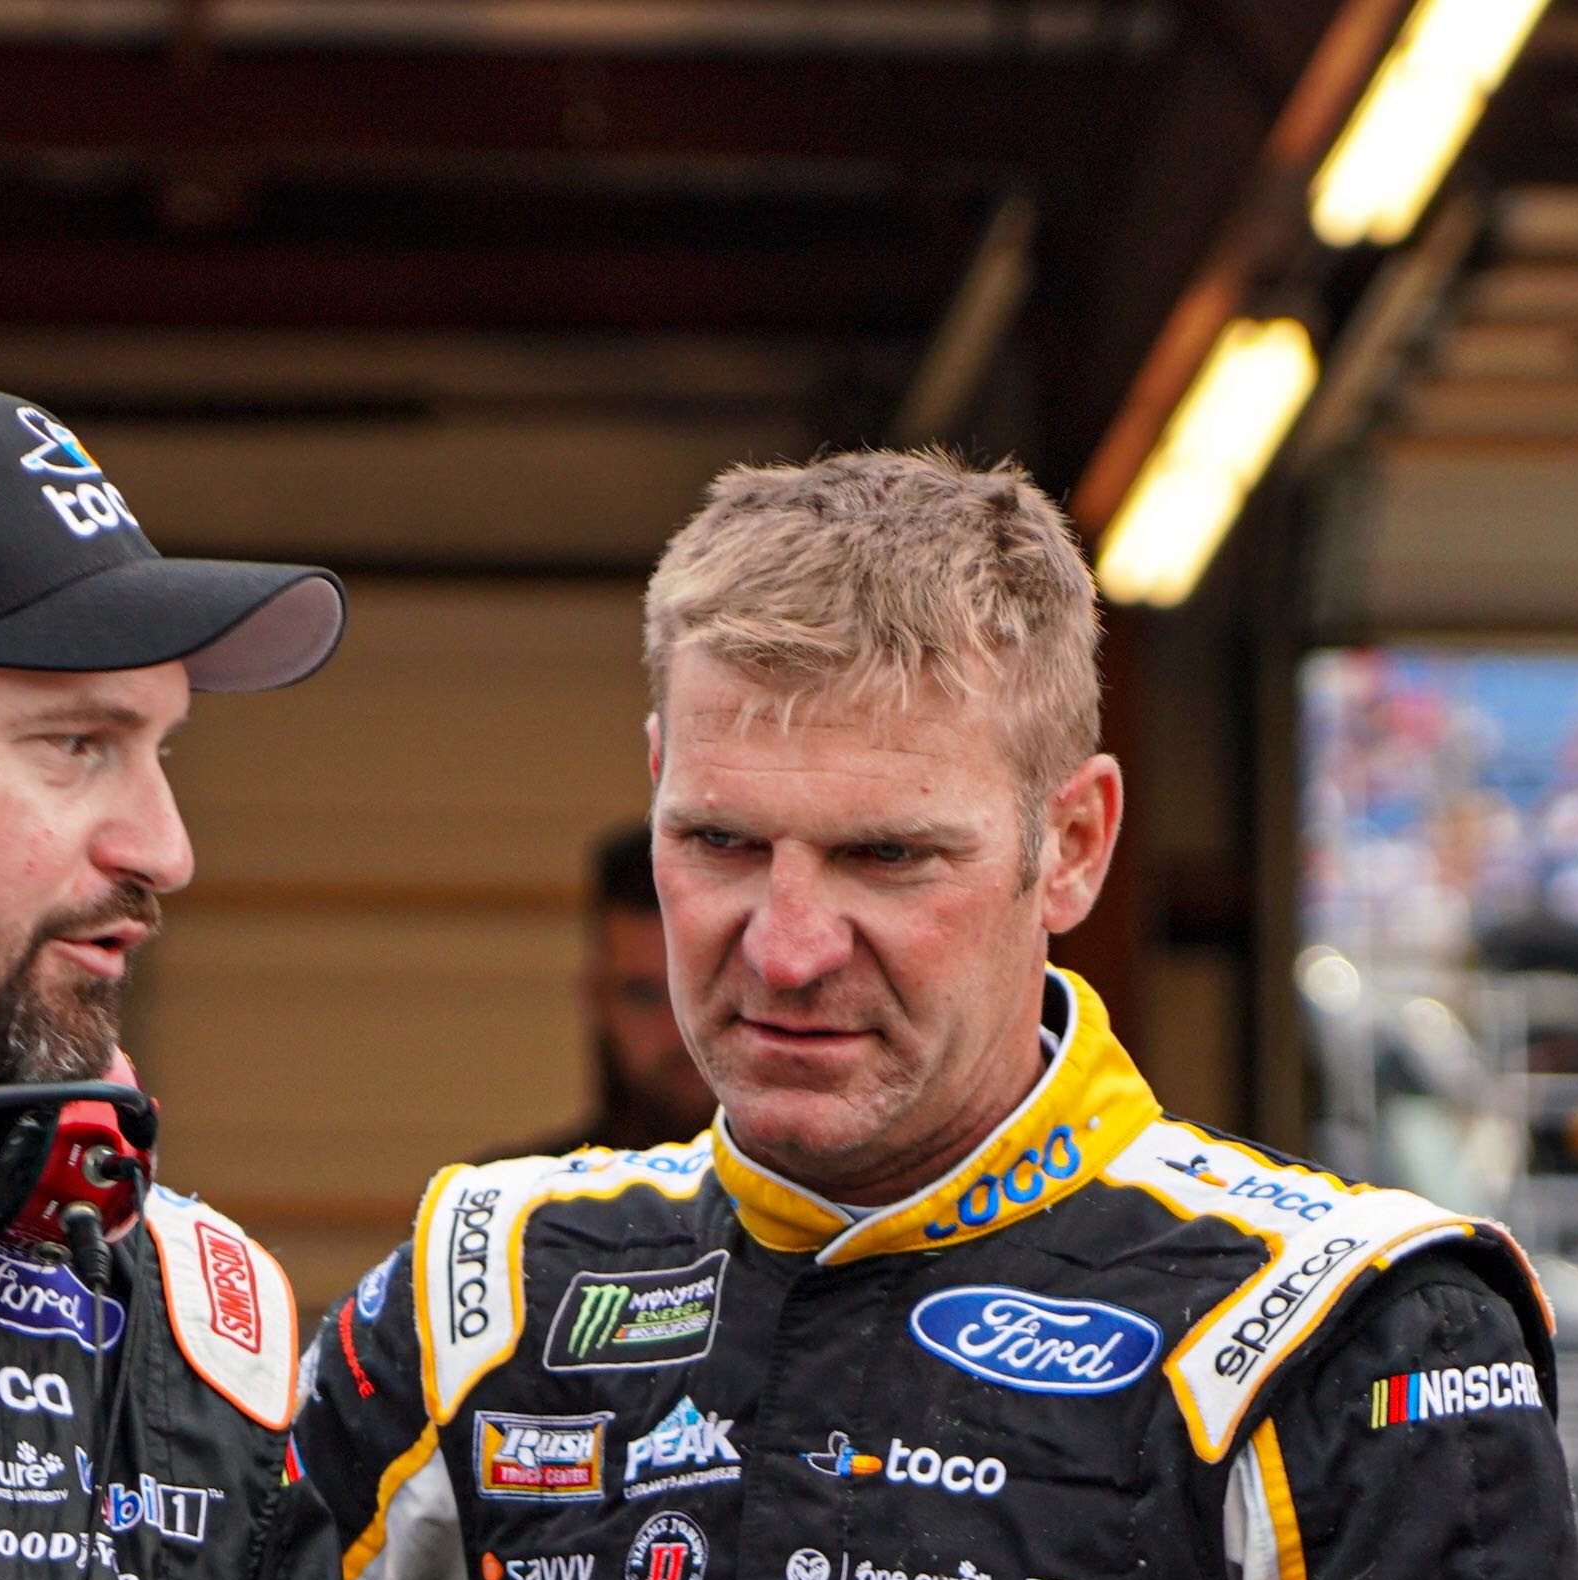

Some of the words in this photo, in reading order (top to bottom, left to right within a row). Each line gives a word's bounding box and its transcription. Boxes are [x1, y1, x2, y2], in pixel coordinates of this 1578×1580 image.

[1227, 1175, 1334, 1222] toco
[206, 1233, 254, 1339] SIMPSON
[455, 1188, 502, 1339] sparco
[957, 1297, 1124, 1380] Ford
[1214, 1236, 1362, 1378] sparco
[1419, 1361, 1544, 1420] NASCAR
[499, 1424, 596, 1468] RUSH
[625, 1411, 742, 1482] PEAK
[885, 1438, 1007, 1496] toco
